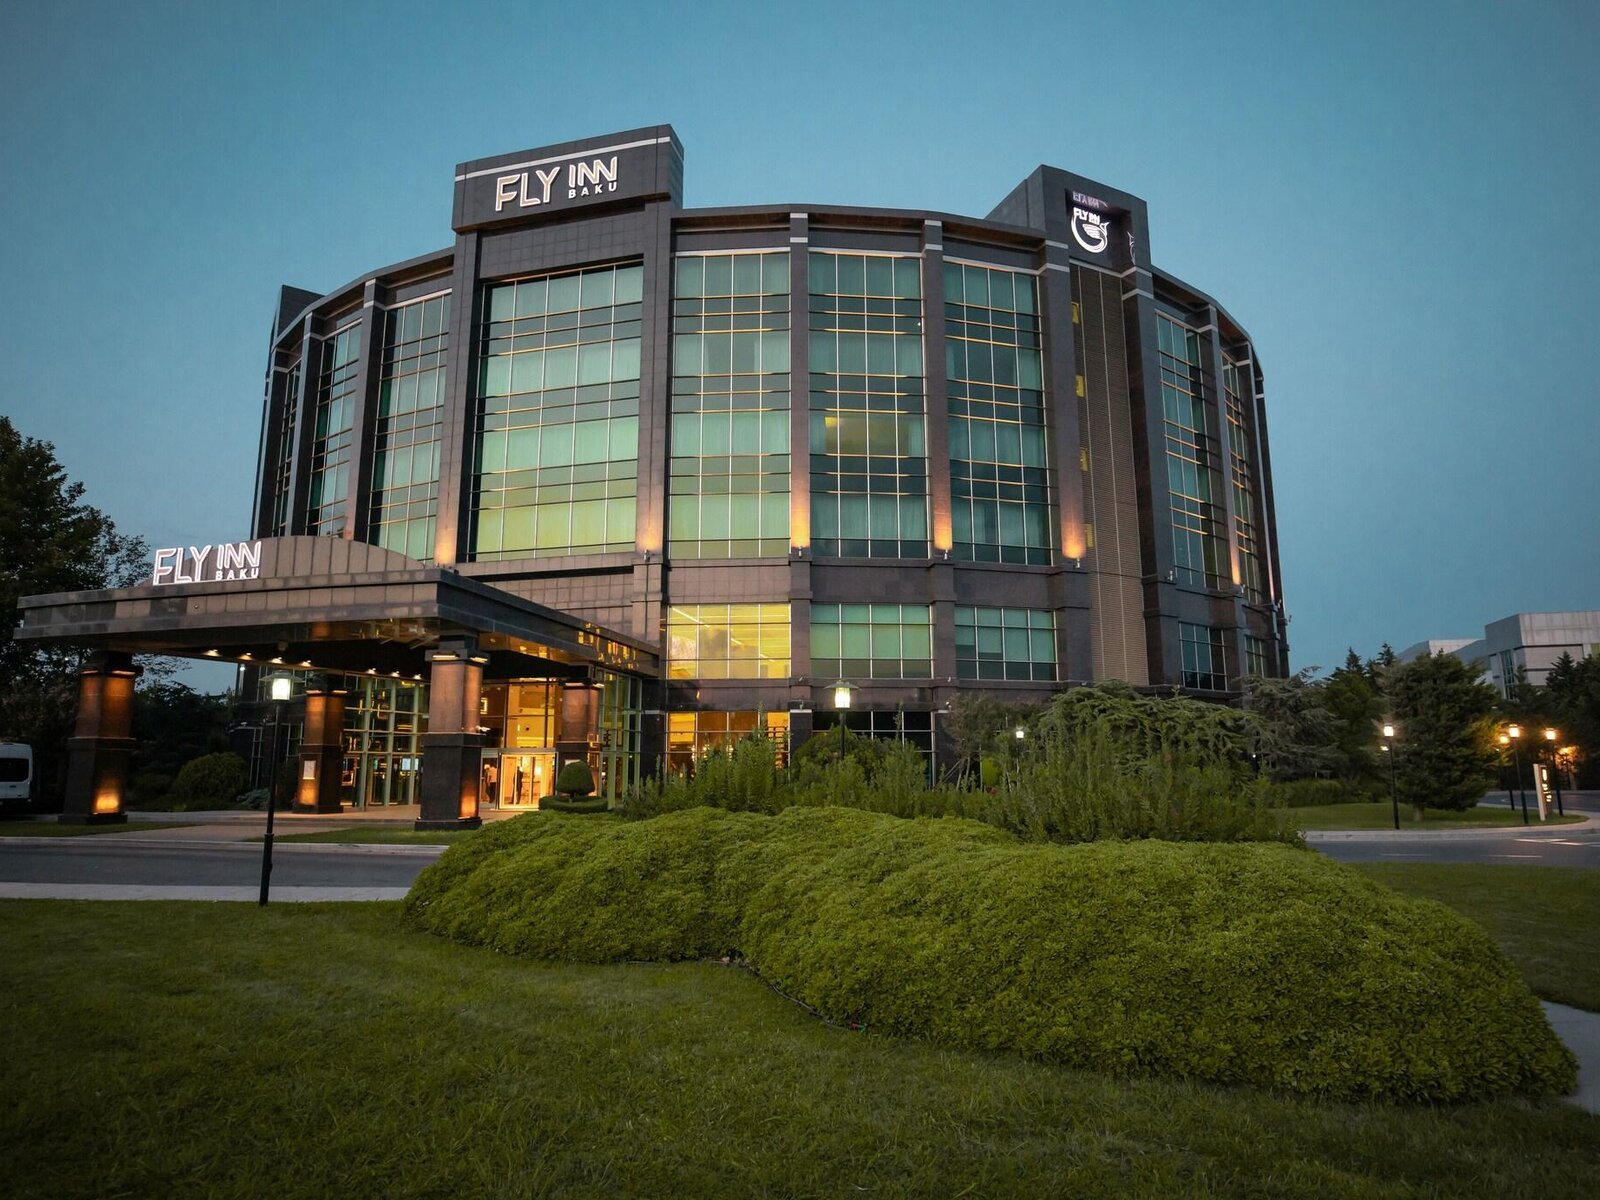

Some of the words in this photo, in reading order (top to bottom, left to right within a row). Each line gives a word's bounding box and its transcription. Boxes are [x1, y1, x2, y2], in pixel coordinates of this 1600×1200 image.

[495, 166, 561, 211] FLY
[568, 156, 618, 188] INN
[568, 181, 617, 199] BAKU
[153, 545, 212, 586] FLY
[216, 541, 262, 570] INN
[215, 567, 259, 581] BAKU
